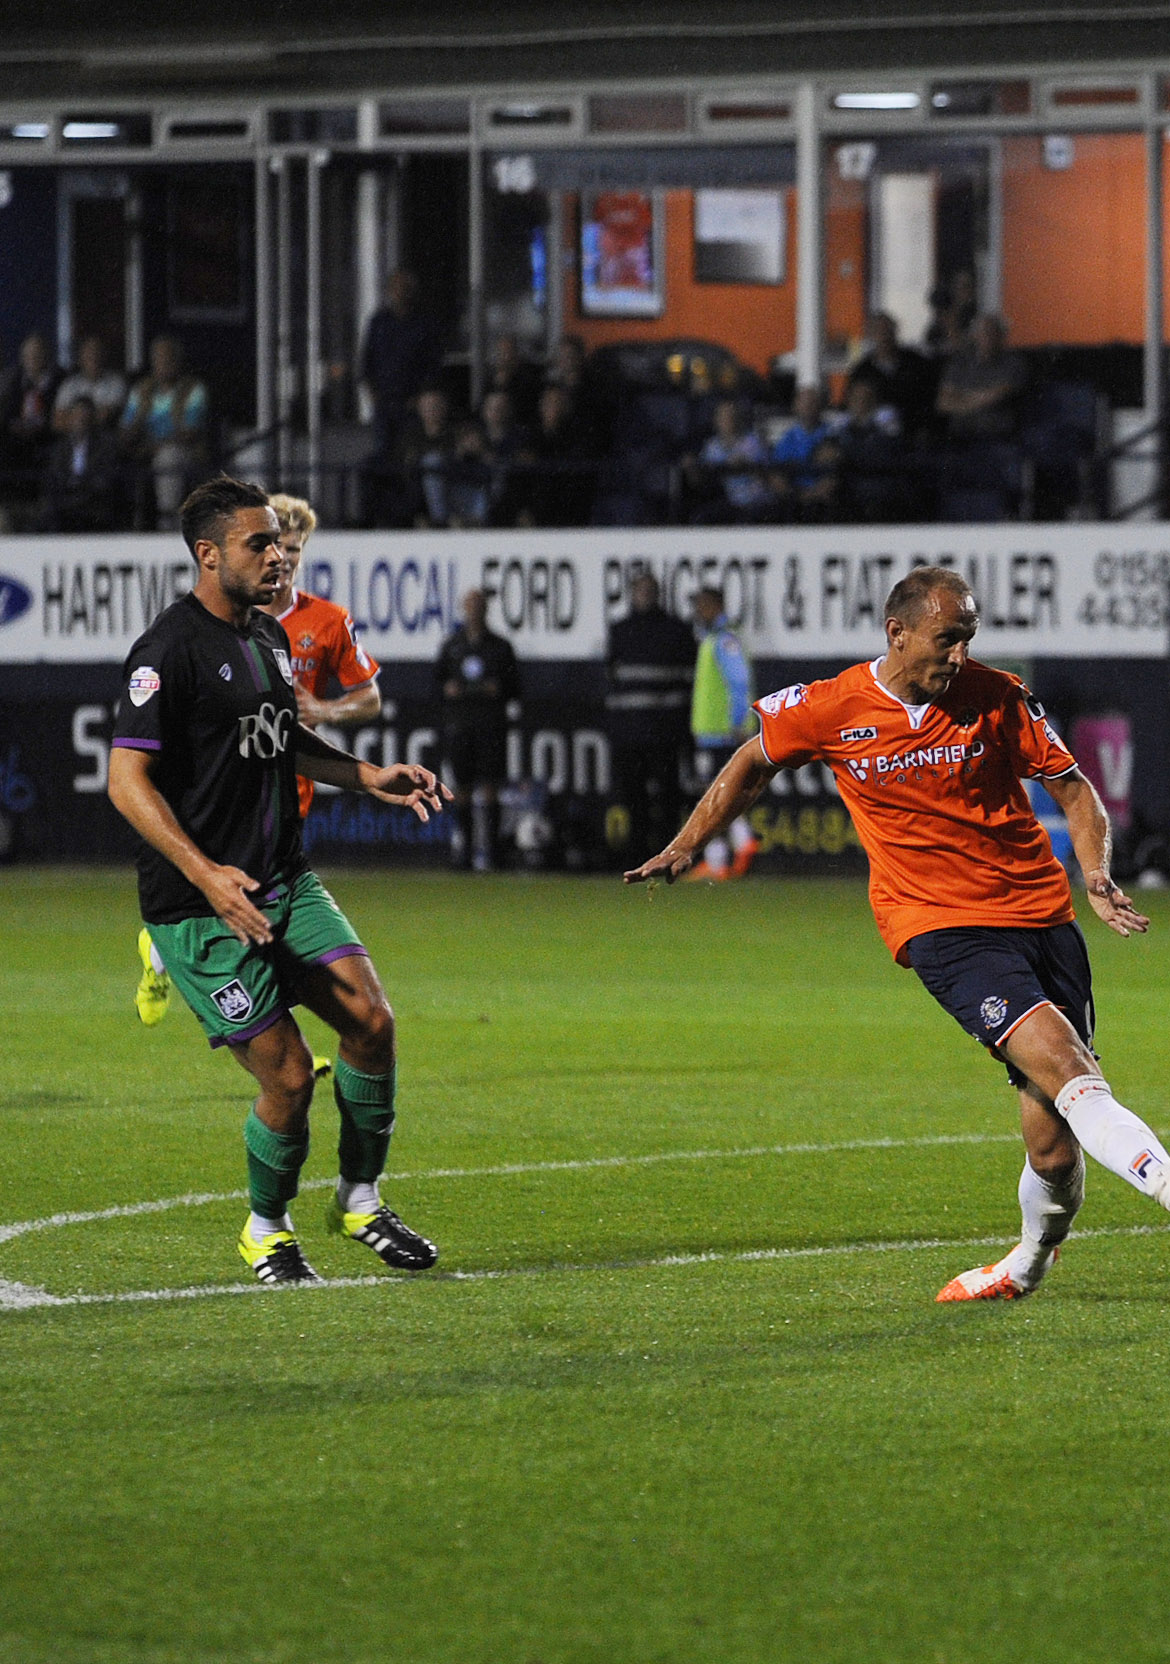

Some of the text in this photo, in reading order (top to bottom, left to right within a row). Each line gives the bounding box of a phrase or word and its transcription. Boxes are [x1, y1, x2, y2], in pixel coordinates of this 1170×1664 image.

[41, 562, 195, 636] HARTWE
[350, 558, 464, 634] LOCAL
[480, 556, 576, 632] FORD
[602, 556, 768, 632] PGOT
[821, 553, 893, 630] FIAT
[903, 552, 1060, 628] ALER
[843, 728, 875, 740] FILA
[876, 740, 985, 773] BARNFIELD
